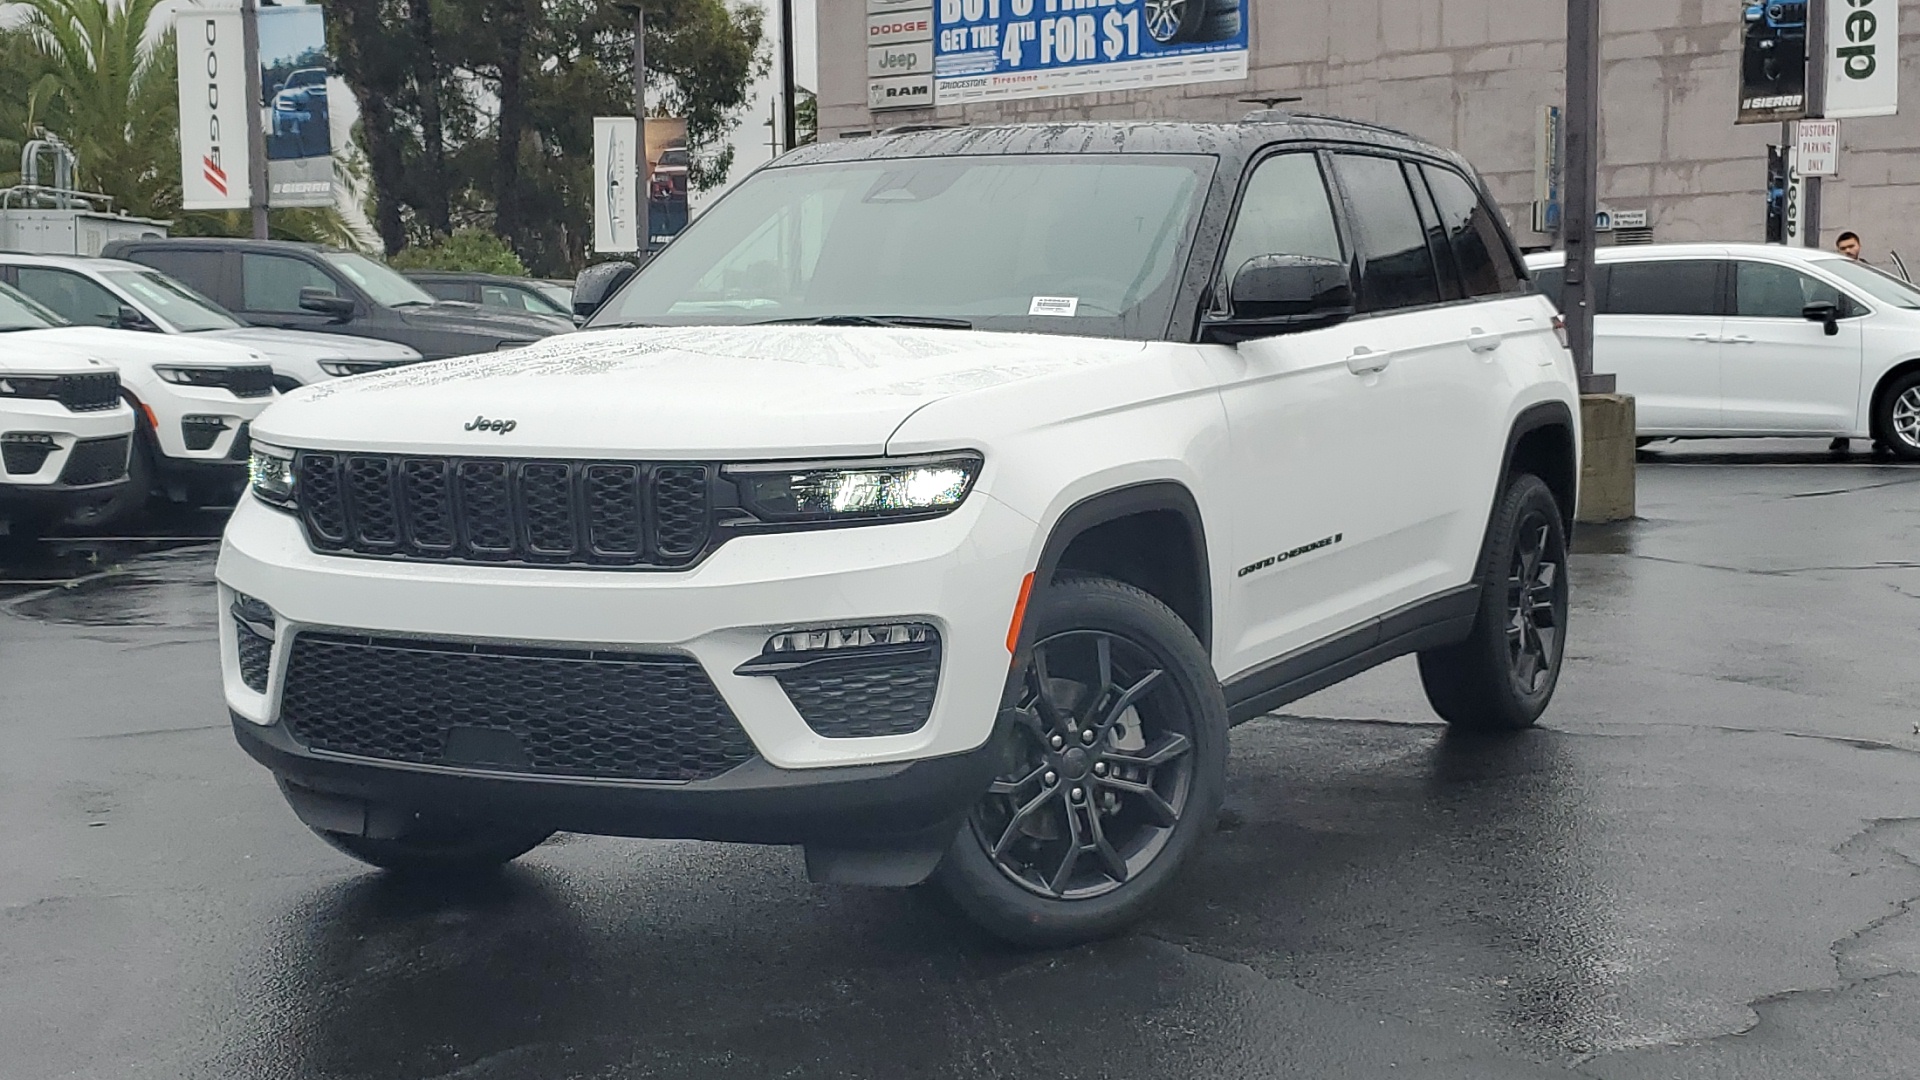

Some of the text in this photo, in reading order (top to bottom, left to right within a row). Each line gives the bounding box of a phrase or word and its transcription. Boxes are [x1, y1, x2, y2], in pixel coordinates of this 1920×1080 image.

[870, 21, 928, 36] DODGE
[940, 27, 968, 52] GET
[970, 25, 1000, 48] THE
[1040, 15, 1096, 64] FOR
[1102, 8, 1139, 61] $1
[878, 49, 917, 70] Jeep
[940, 79, 987, 90] BRIDGESTONE
[992, 75, 1038, 85] Firestone
[205, 19, 222, 170] DODGE
[886, 86, 928, 97] RAM
[1751, 95, 1802, 109] SIERRA
[1800, 124, 1835, 137] CUSTOMER
[1803, 142, 1831, 153] PARKING
[1808, 160, 1824, 171] ONLY
[1787, 165, 1800, 238] Jeep
[464, 415, 517, 436] Jeep
[1238, 536, 1333, 578] GRAND CHEROKEE
